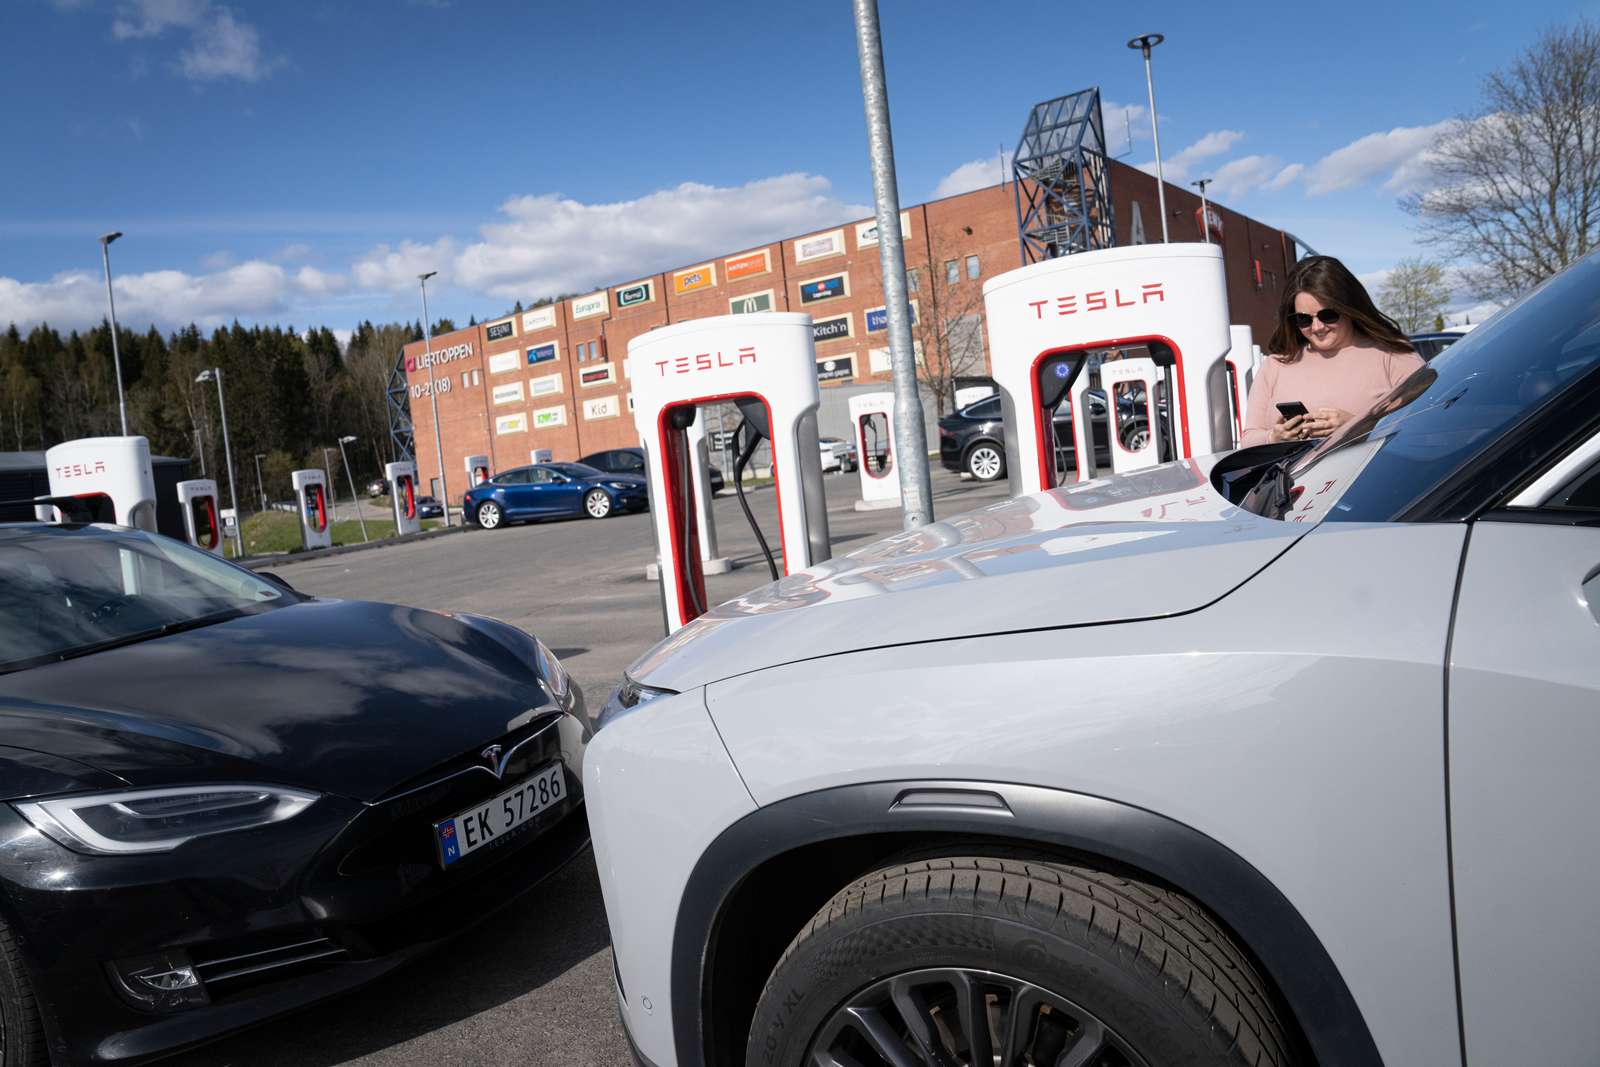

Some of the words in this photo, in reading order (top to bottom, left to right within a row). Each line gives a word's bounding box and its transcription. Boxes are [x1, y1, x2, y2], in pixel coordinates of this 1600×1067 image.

[1029, 283, 1165, 319] TESLA
[814, 323, 847, 338] Kitch'n
[416, 342, 473, 370] LIERTOPPEN
[655, 346, 756, 377] TESLA
[591, 403, 608, 416] Kid
[56, 461, 105, 478] TESLA
[463, 807, 494, 848] EK
[503, 770, 561, 828] 57286
[447, 846, 456, 856] N
